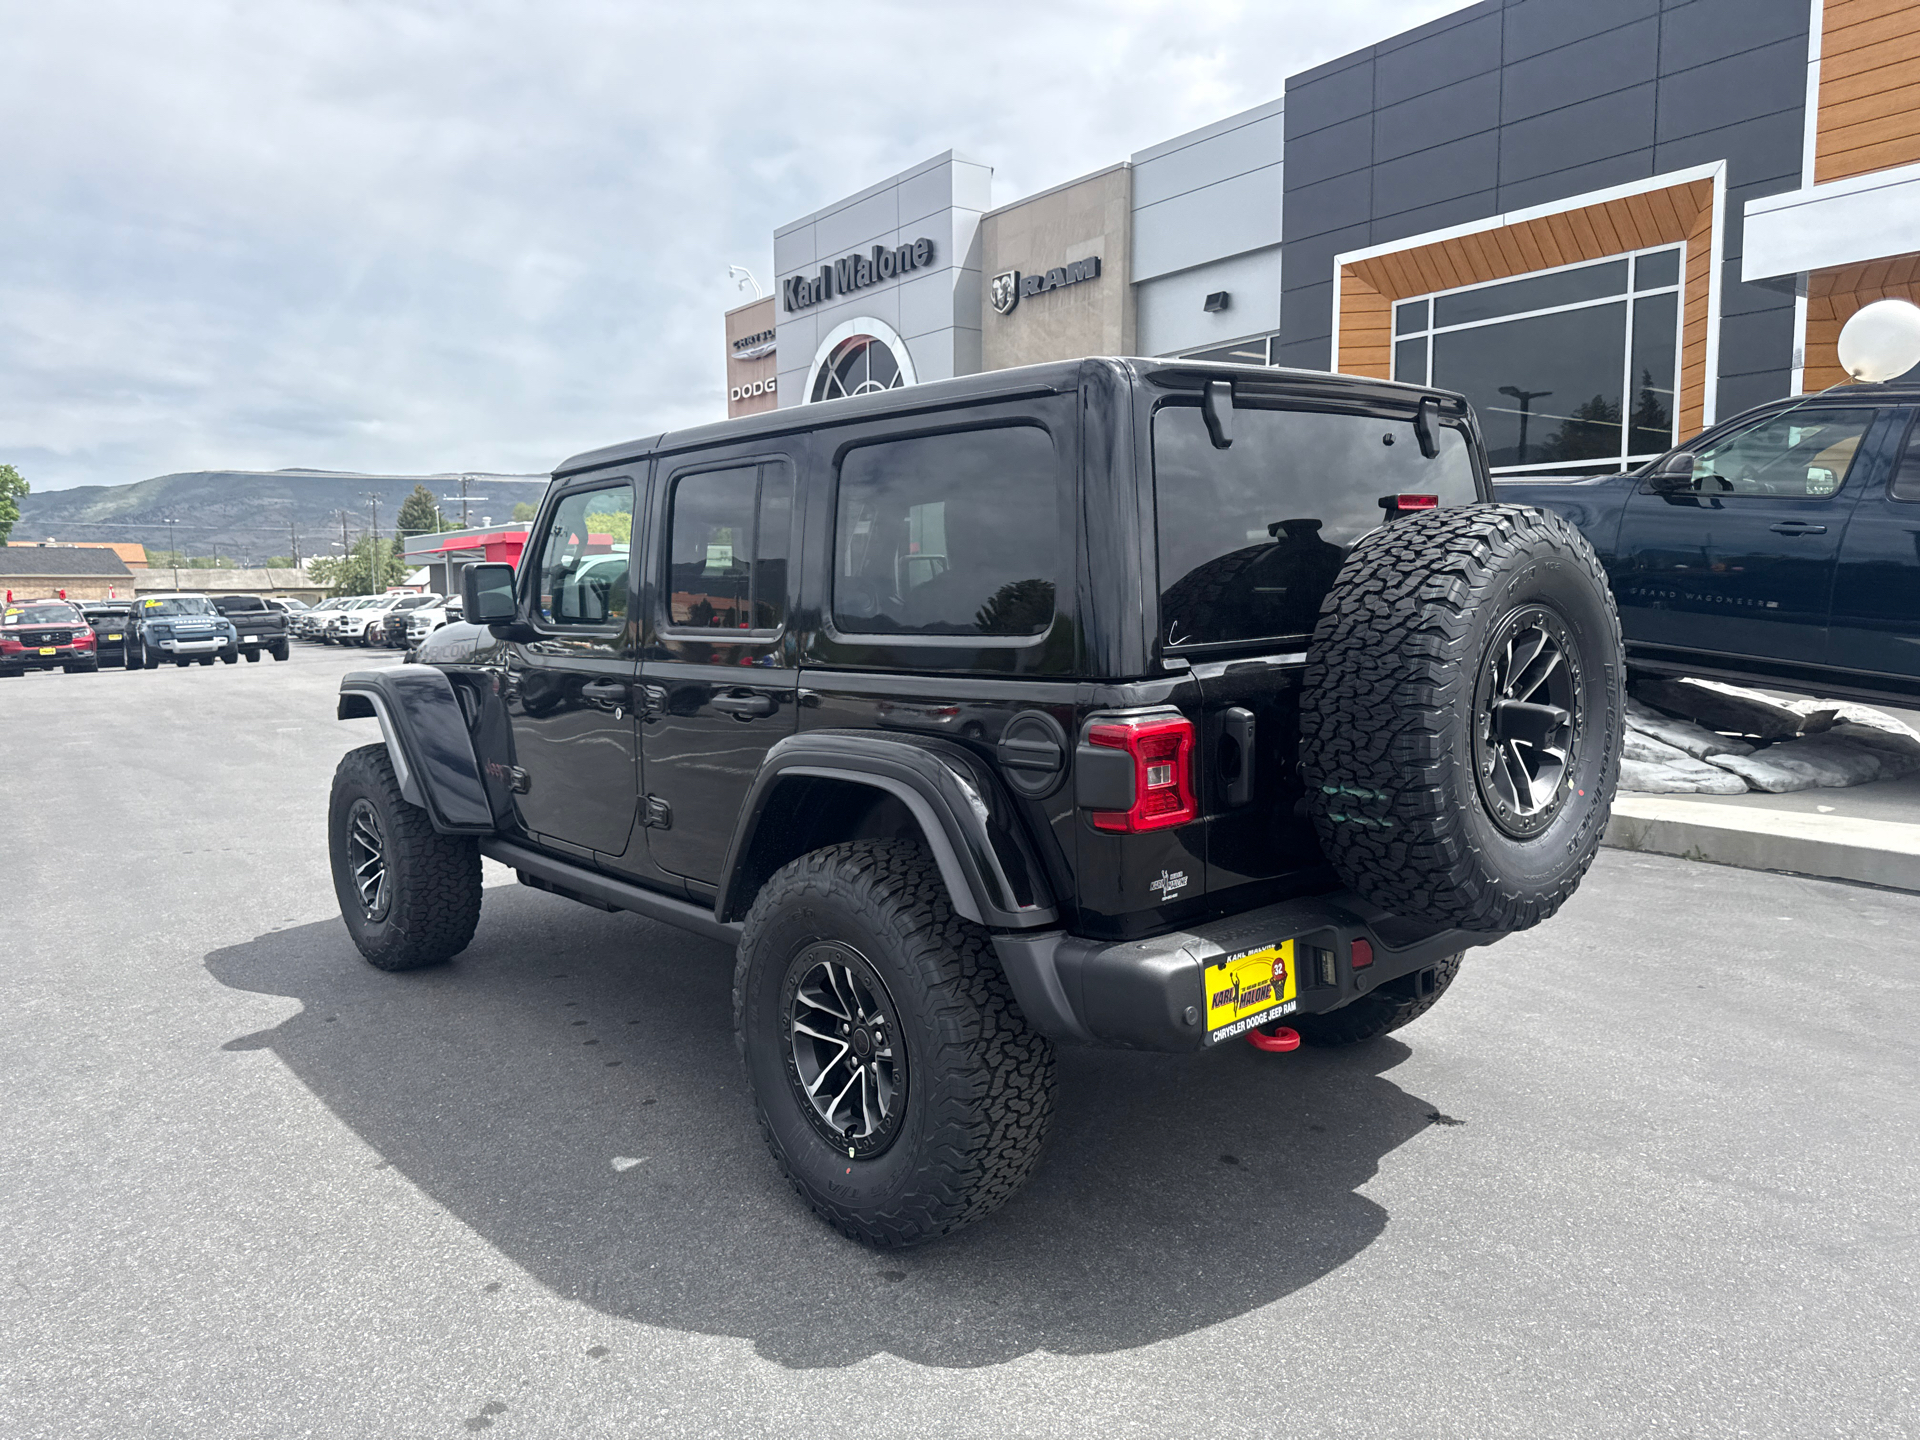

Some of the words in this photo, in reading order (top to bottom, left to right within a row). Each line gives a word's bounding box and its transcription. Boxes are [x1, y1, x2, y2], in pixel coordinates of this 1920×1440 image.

[783, 265, 832, 312] Karl
[834, 237, 934, 295] Malone
[1020, 256, 1101, 298] RAM
[731, 377, 776, 401] DODG
[1628, 587, 1676, 598] GRAND
[1684, 592, 1765, 606] WAGONEER
[1274, 963, 1283, 975] 32
[1211, 986, 1235, 1010] KARL
[1239, 984, 1272, 1009] MALONE
[1213, 1022, 1246, 1042] CHRYSLER
[1246, 1013, 1268, 1030] DODGE
[1268, 1006, 1283, 1021] JEEP
[1283, 1001, 1297, 1014] RAM
